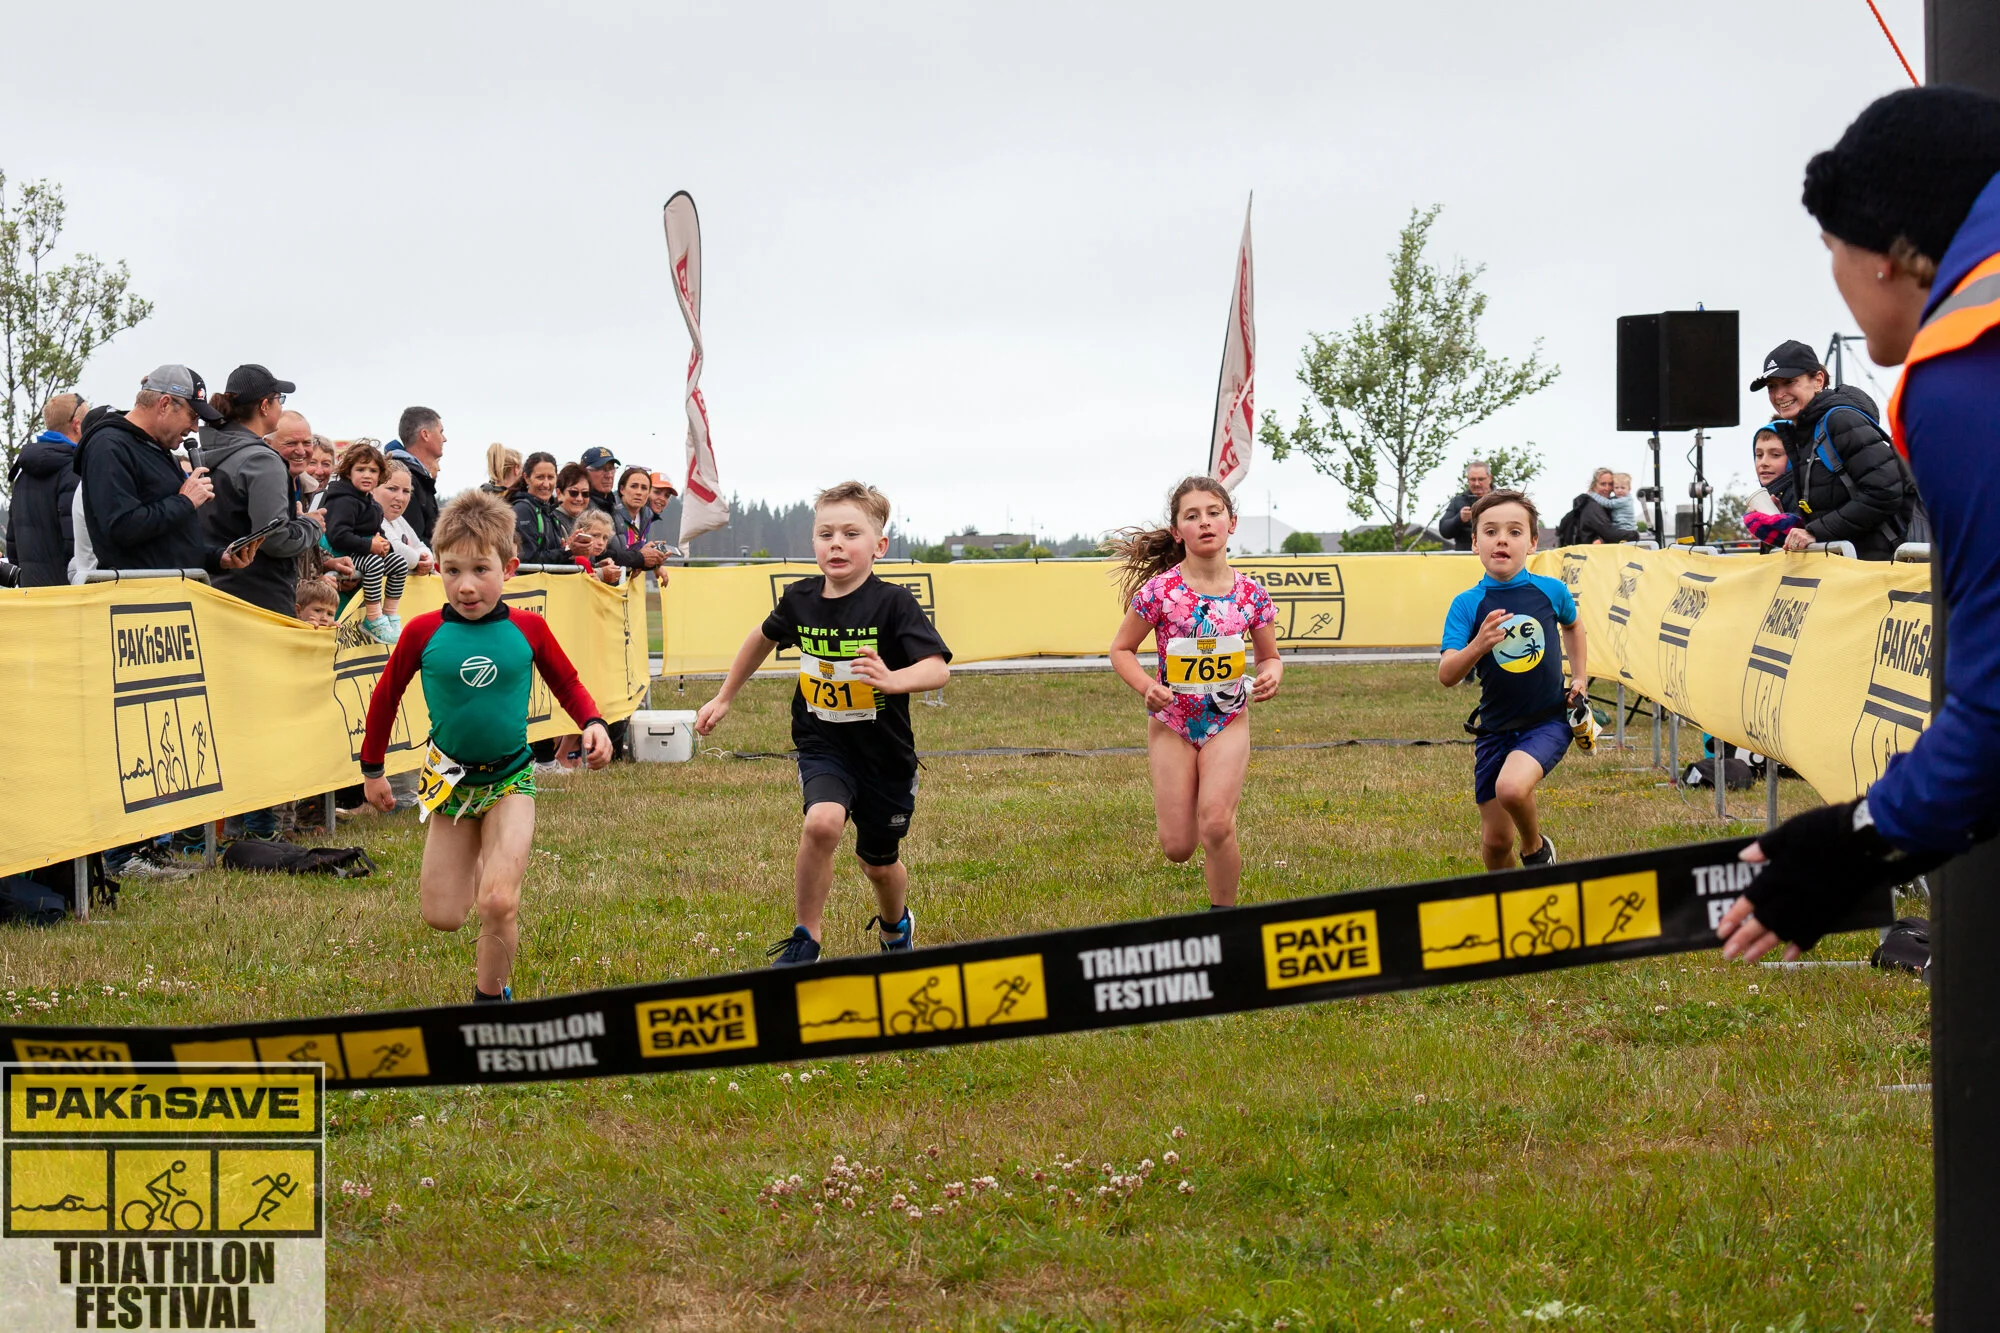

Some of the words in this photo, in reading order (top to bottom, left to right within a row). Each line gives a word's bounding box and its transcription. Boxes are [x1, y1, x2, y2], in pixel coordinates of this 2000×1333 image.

[117, 624, 195, 667] PAK'nSAVE
[846, 627, 878, 636] THE
[1879, 618, 1932, 678] PAK'nSA
[1181, 656, 1232, 681] 765
[809, 678, 853, 708] 731
[1077, 934, 1222, 980] TRIATHLON
[1278, 947, 1369, 979] SAVE
[1094, 970, 1215, 1012] FESTIVAL
[458, 1011, 606, 1047] TRIATHLON
[652, 1021, 746, 1049] SAVE
[476, 1041, 599, 1072] FESTIVAL
